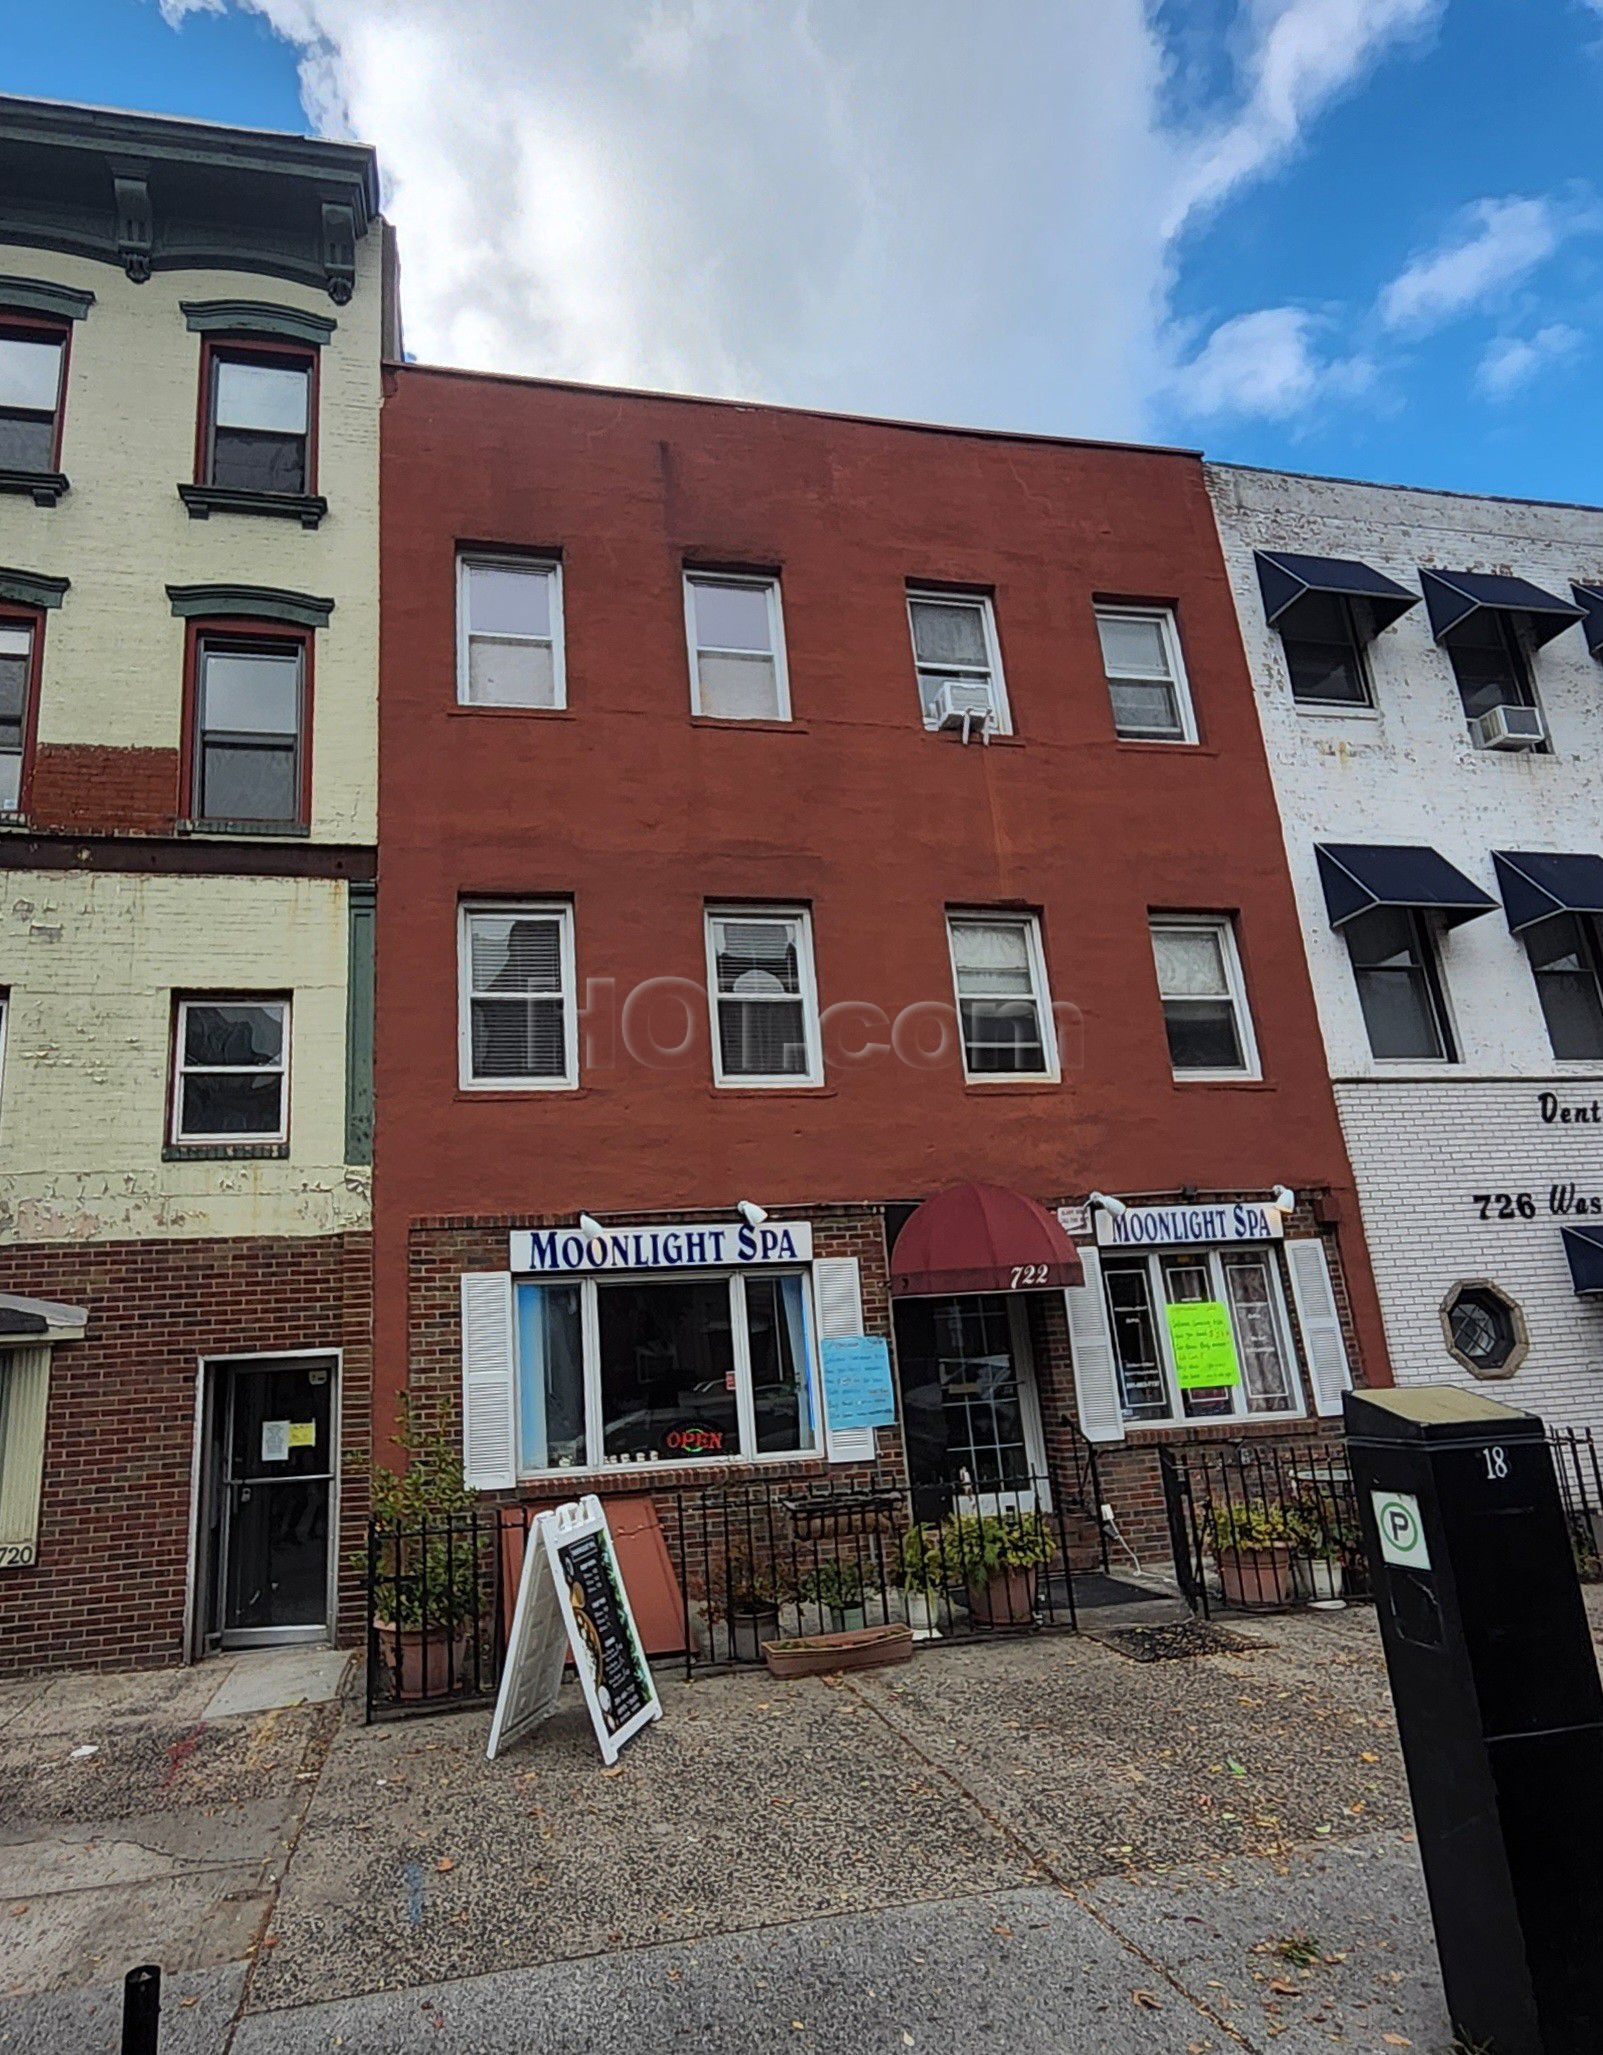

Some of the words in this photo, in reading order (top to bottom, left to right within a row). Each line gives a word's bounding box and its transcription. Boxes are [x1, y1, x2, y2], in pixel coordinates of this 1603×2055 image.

[1538, 1092, 1602, 1124] Dent
[1473, 1192, 1536, 1220] 726
[1112, 1211, 1226, 1242] MOONLIGHT
[1233, 1203, 1272, 1238] SPA
[529, 1230, 726, 1270] MOONLIGHT
[737, 1224, 798, 1261] SPA
[1011, 1263, 1049, 1289] 722
[666, 1430, 724, 1449] OPEN
[1482, 1446, 1508, 1479] 18
[1389, 1510, 1409, 1542] P
[0, 1545, 33, 1565] 720
